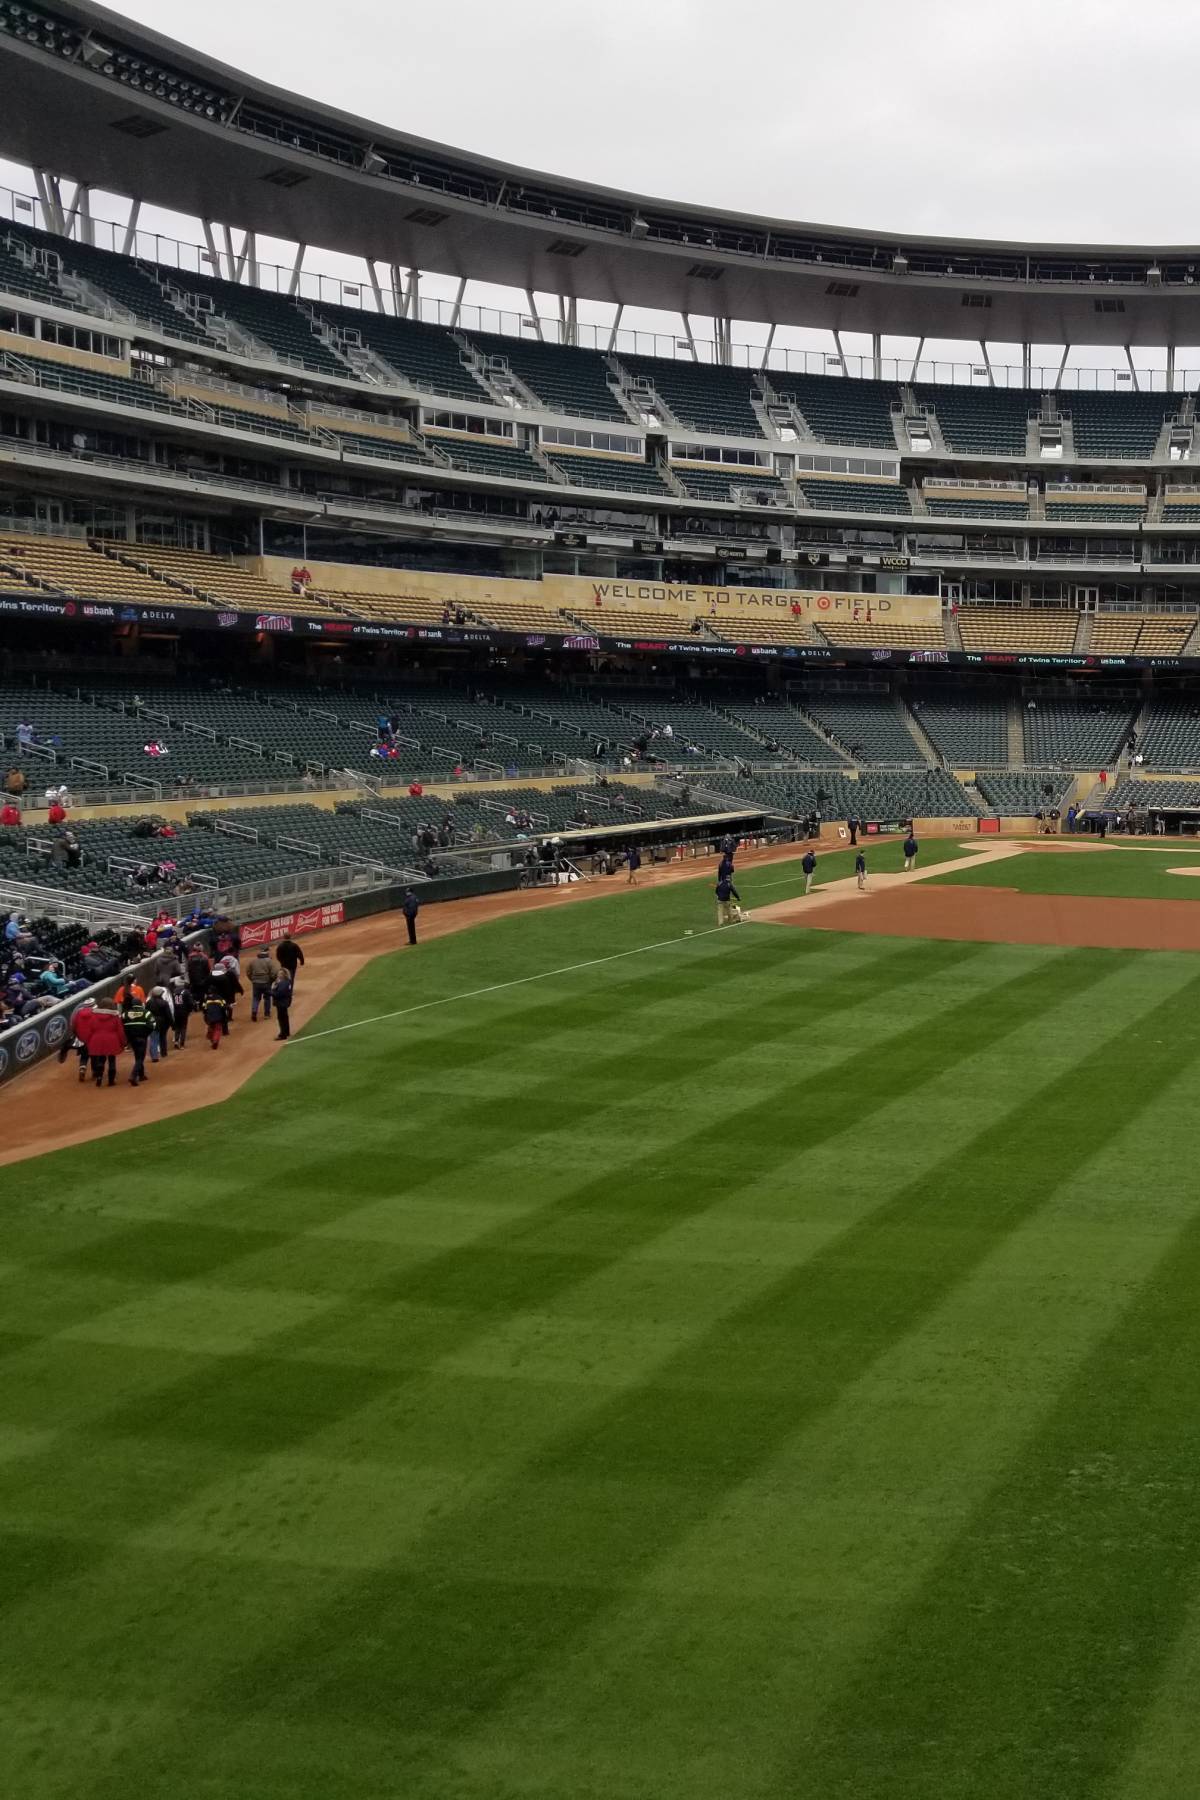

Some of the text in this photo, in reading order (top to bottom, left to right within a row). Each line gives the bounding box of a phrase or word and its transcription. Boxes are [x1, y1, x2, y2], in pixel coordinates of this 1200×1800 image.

[882, 557, 908, 566] WCCO
[592, 583, 814, 609] WELCOME TO TARGET
[19, 601, 66, 614] Territory
[835, 598, 892, 612] FIELD
[149, 610, 175, 620] DELTA
[308, 622, 322, 631] The
[615, 641, 632, 649] The
[678, 644, 700, 652] Twins
[701, 646, 737, 655] Territory
[1051, 657, 1087, 665] Territory
